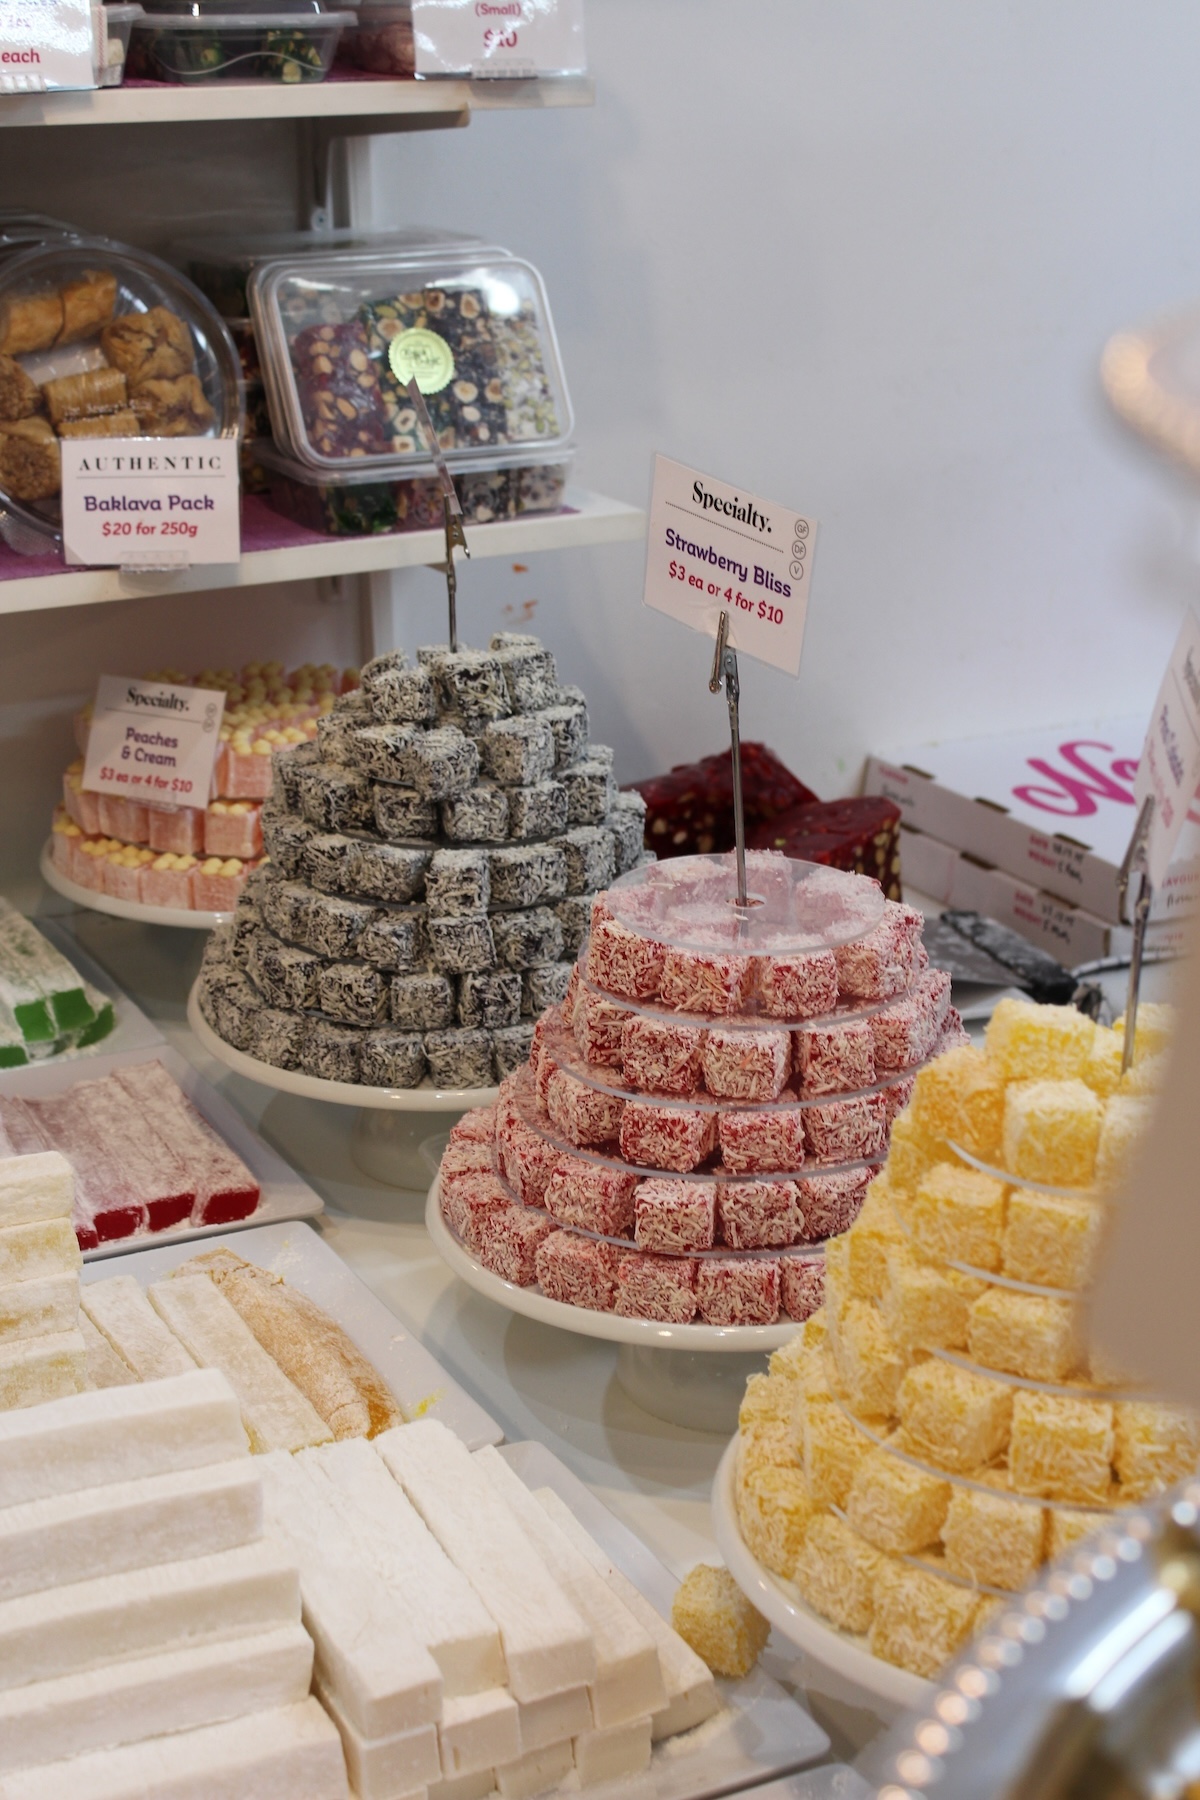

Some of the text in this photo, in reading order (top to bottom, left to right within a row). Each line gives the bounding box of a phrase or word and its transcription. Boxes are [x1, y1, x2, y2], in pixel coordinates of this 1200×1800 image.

[475, 2, 522, 17] (Small)
[1, 47, 41, 64] each
[79, 456, 222, 472] AUTHENTIC
[83, 494, 215, 512] Baklava Pack
[692, 480, 772, 534] Specialty.
[102, 521, 199, 538] $20 for 250g
[665, 528, 792, 598] Strawberry Bliss
[668, 560, 784, 625] $3 ea or 4 for $10
[126, 686, 190, 712] Specialty.
[125, 727, 178, 749] Peaches
[134, 748, 177, 768] Cream
[99, 767, 193, 793] $3 ea or 4 for $10
